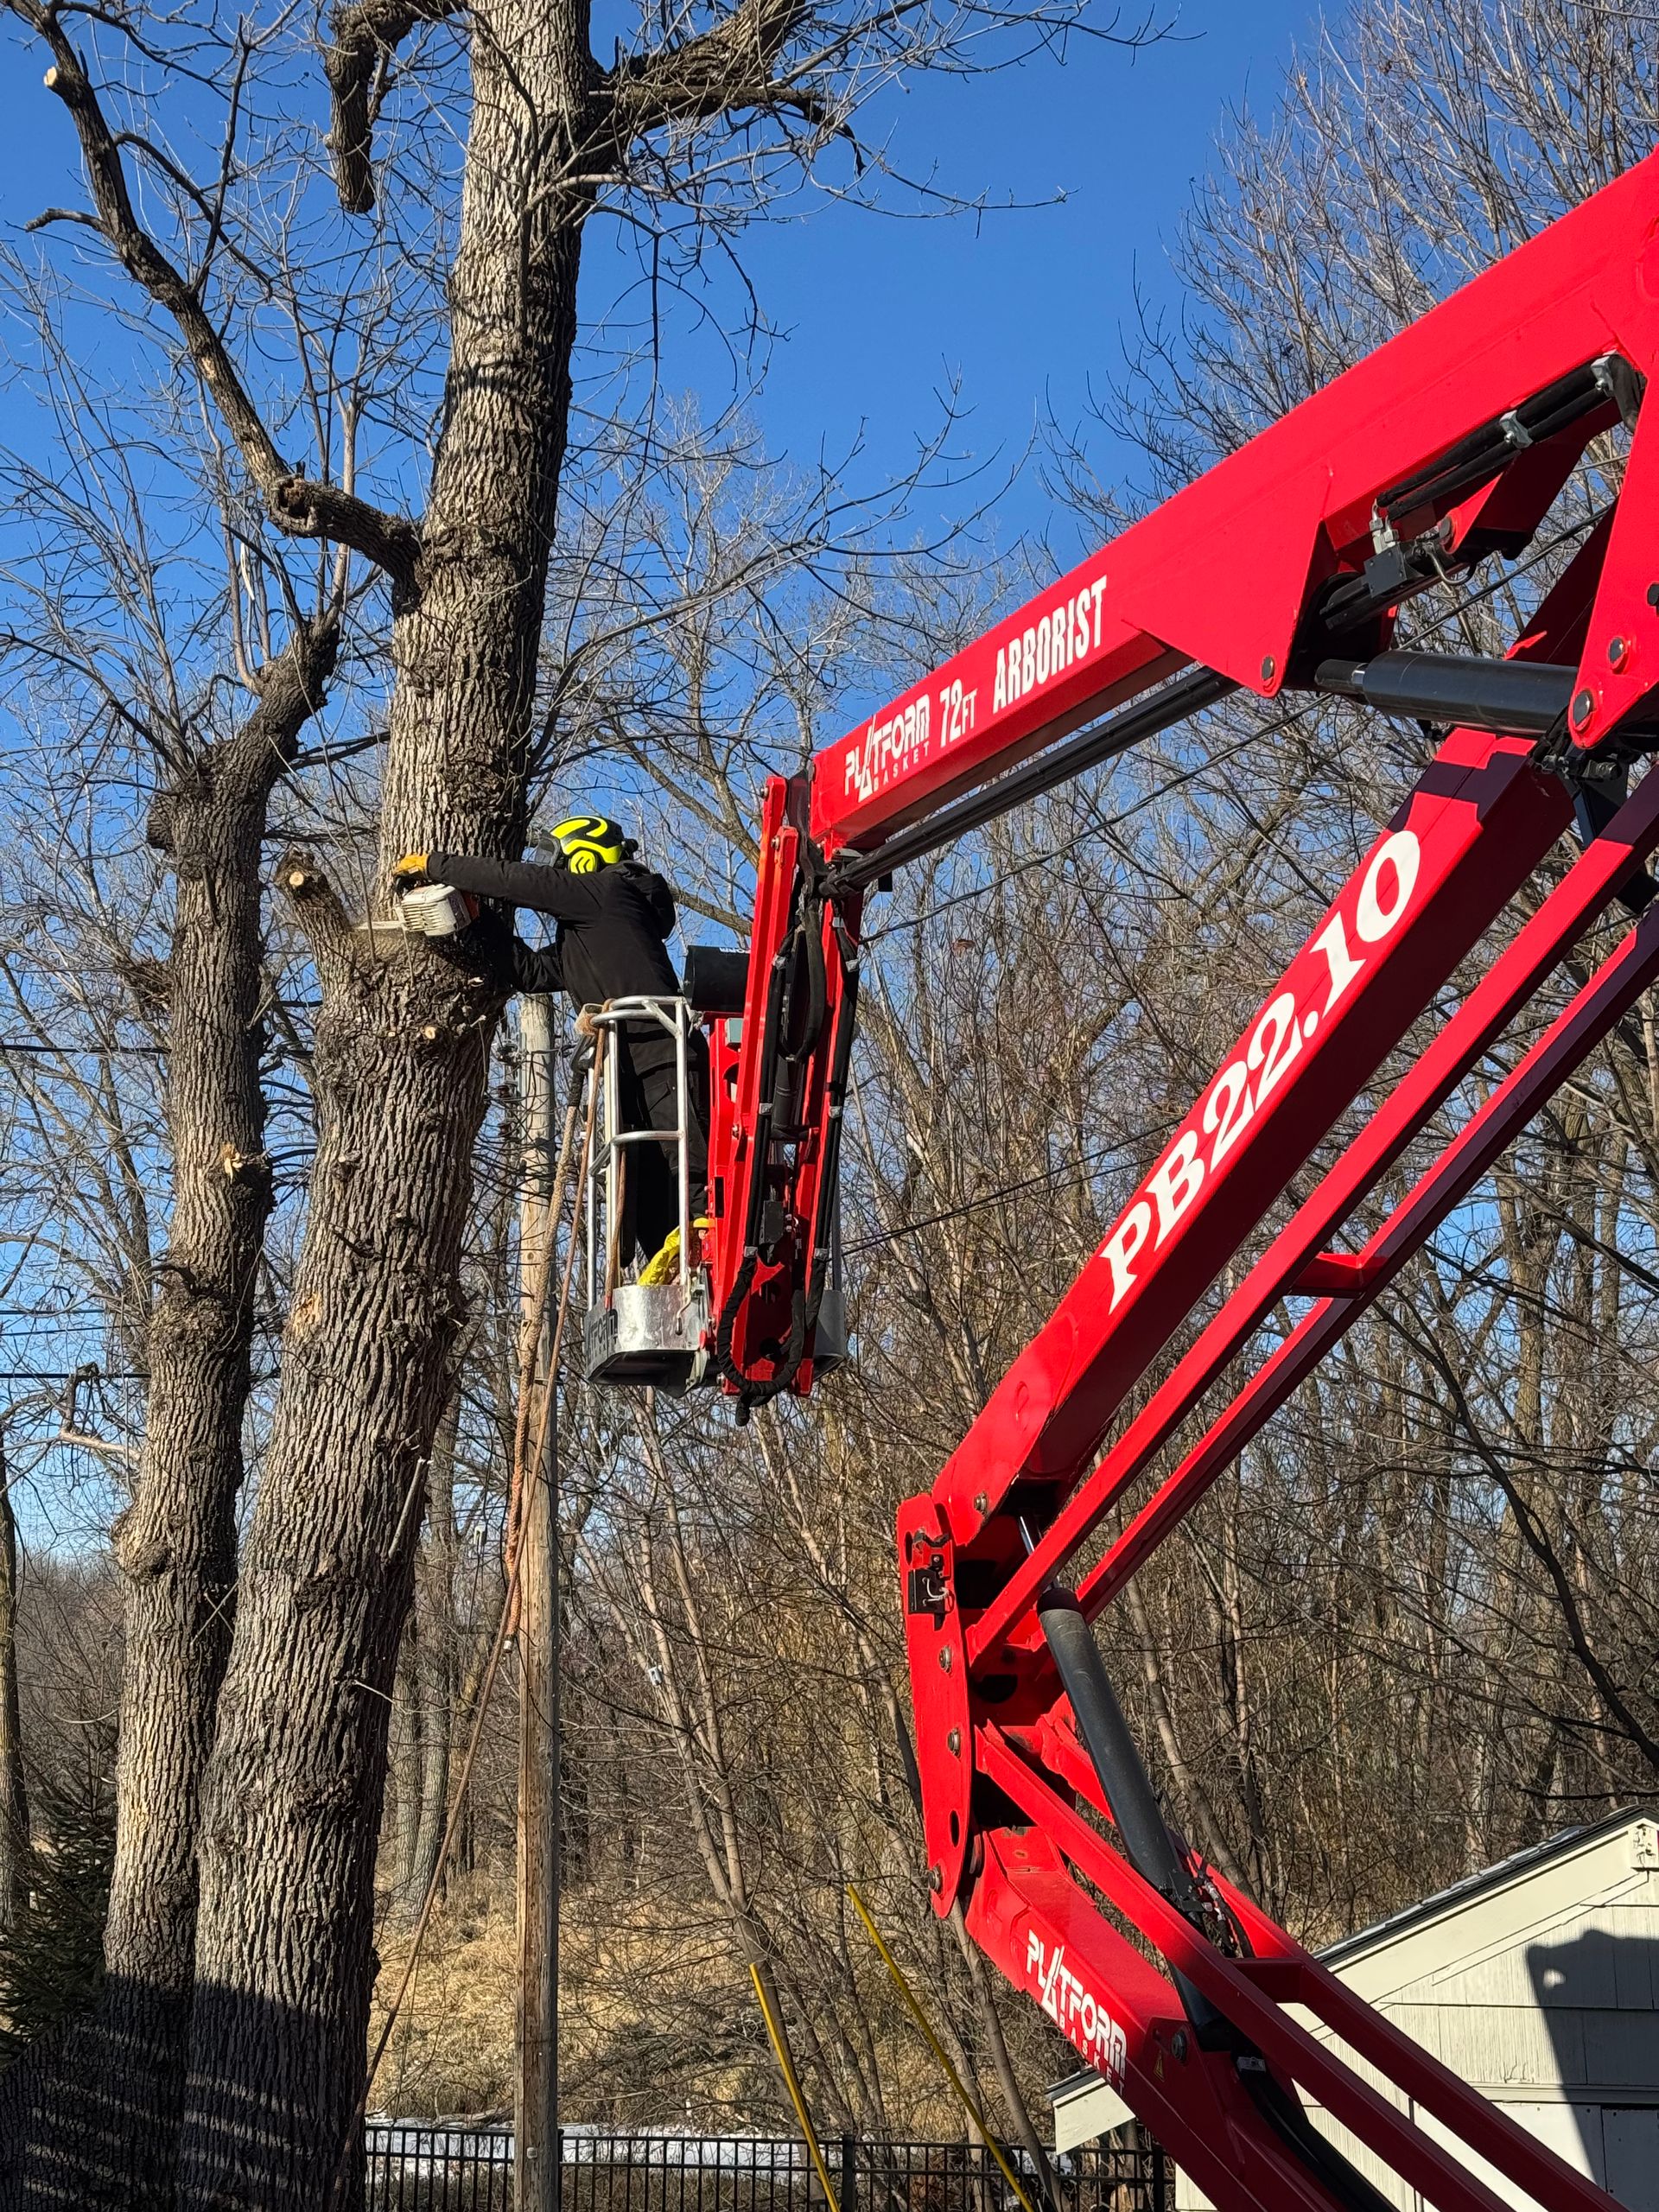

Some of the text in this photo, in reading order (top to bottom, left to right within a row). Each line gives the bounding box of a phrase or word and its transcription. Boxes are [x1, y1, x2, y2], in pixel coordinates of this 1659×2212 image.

[844, 693, 931, 803] PLATFORM
[993, 575, 1107, 715] ARBORIST
[873, 741, 930, 791] BASKET
[1099, 830, 1421, 1313] PB22.10
[1026, 1929, 1127, 2080] PLATFORM
[1059, 2016, 1124, 2097] BASKET
